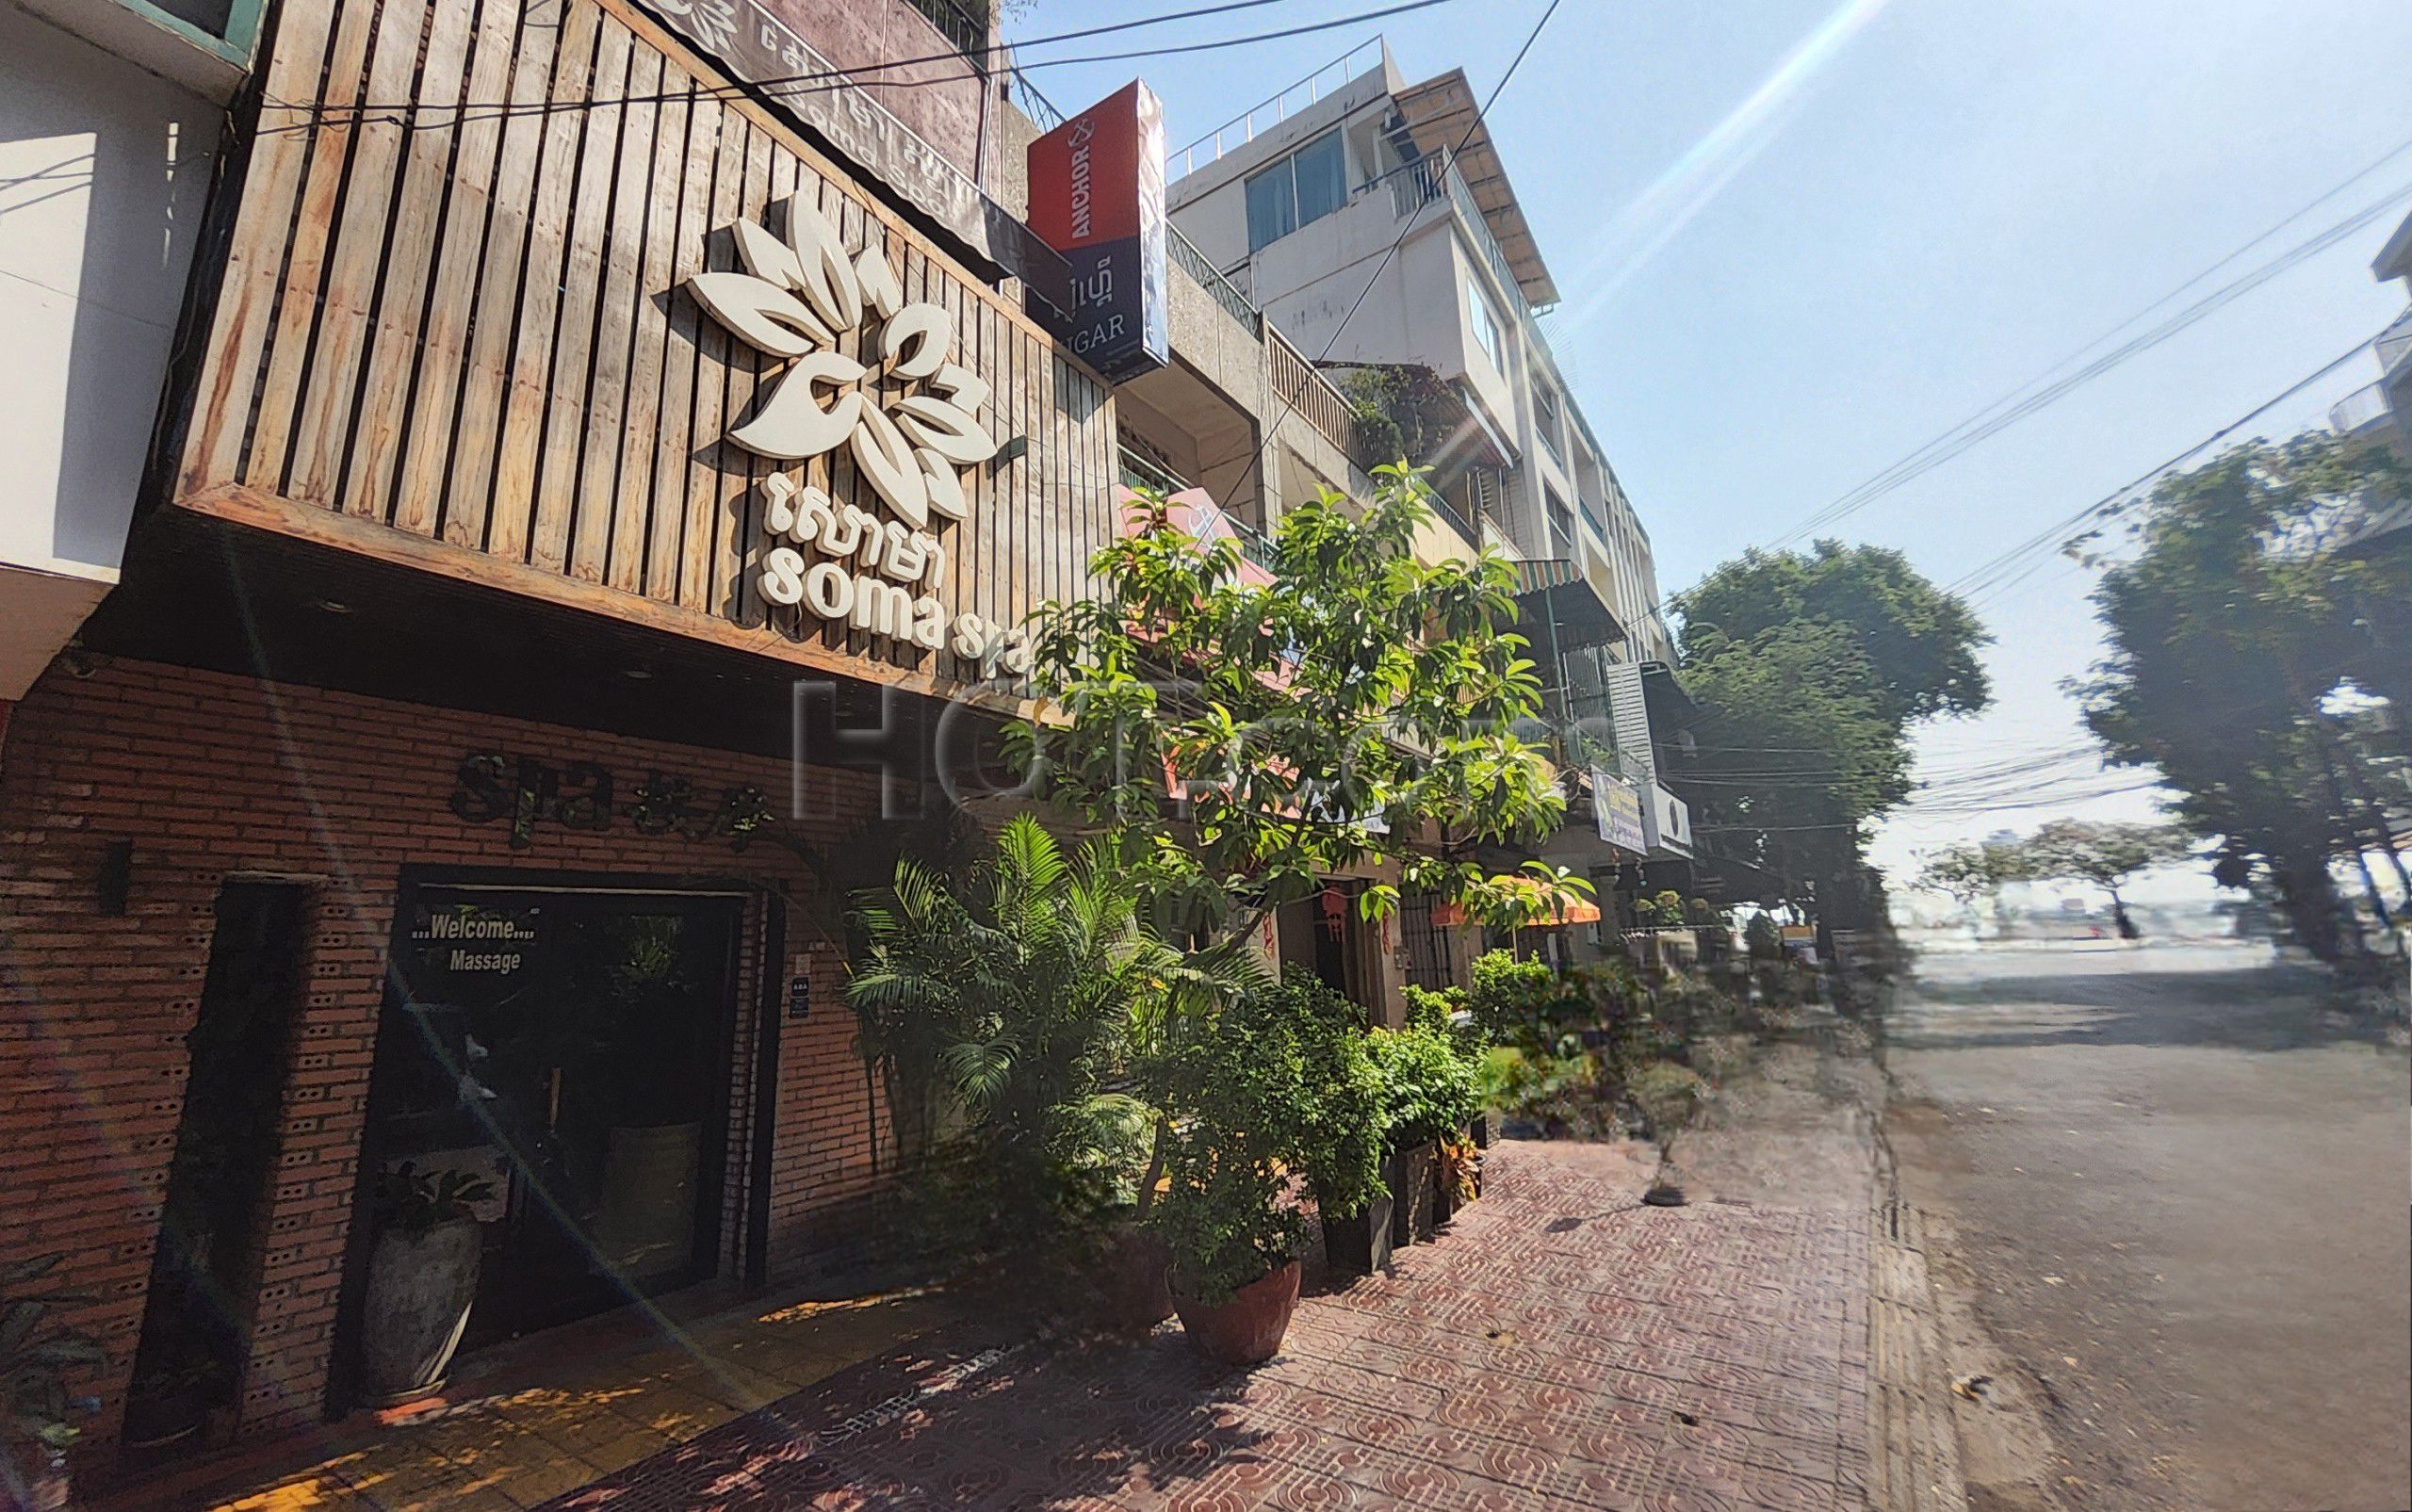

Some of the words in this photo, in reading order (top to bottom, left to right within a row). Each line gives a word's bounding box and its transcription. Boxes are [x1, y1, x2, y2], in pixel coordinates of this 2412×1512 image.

[785, 79, 877, 168] Soma
[888, 163, 946, 218] Spa
[1070, 145, 1092, 239] ANCHOR
[449, 754, 614, 851] Spa
[449, 949, 521, 975] Massage
